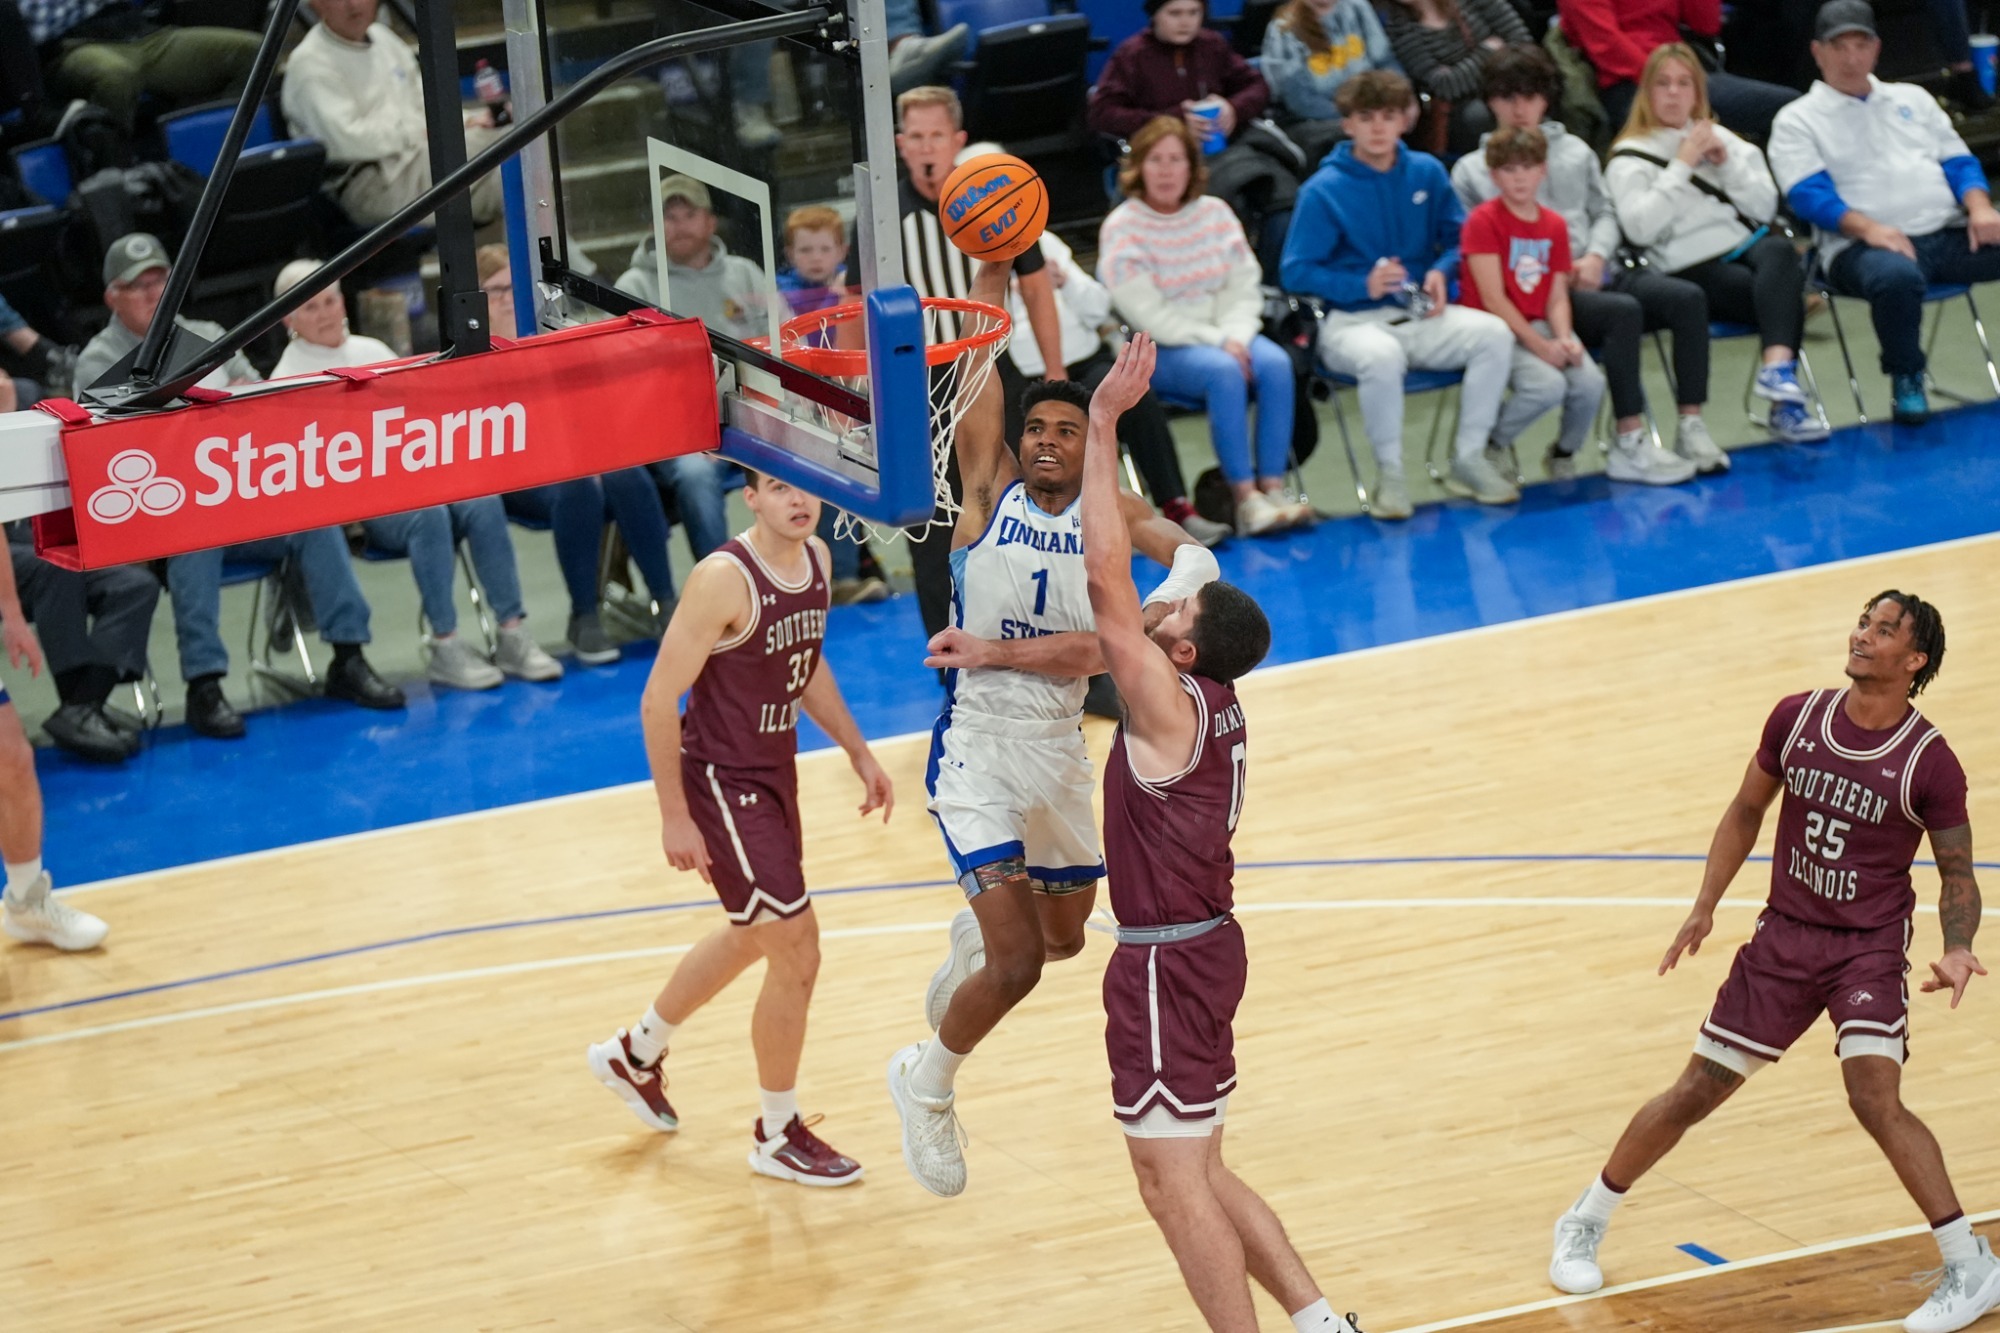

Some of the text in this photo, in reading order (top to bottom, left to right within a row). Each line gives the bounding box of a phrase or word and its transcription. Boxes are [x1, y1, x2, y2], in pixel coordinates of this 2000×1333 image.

[946, 174, 1013, 222] Wilson
[979, 208, 1017, 243] EVO
[1031, 569, 1048, 617] 1
[765, 609, 827, 655] SOUTHER
[786, 648, 813, 693] 33
[1214, 703, 1244, 738] DAMI
[1787, 766, 1888, 825] SOUTHERN
[1805, 811, 1851, 860] 25
[1789, 846, 1858, 901] ILLINOIS
